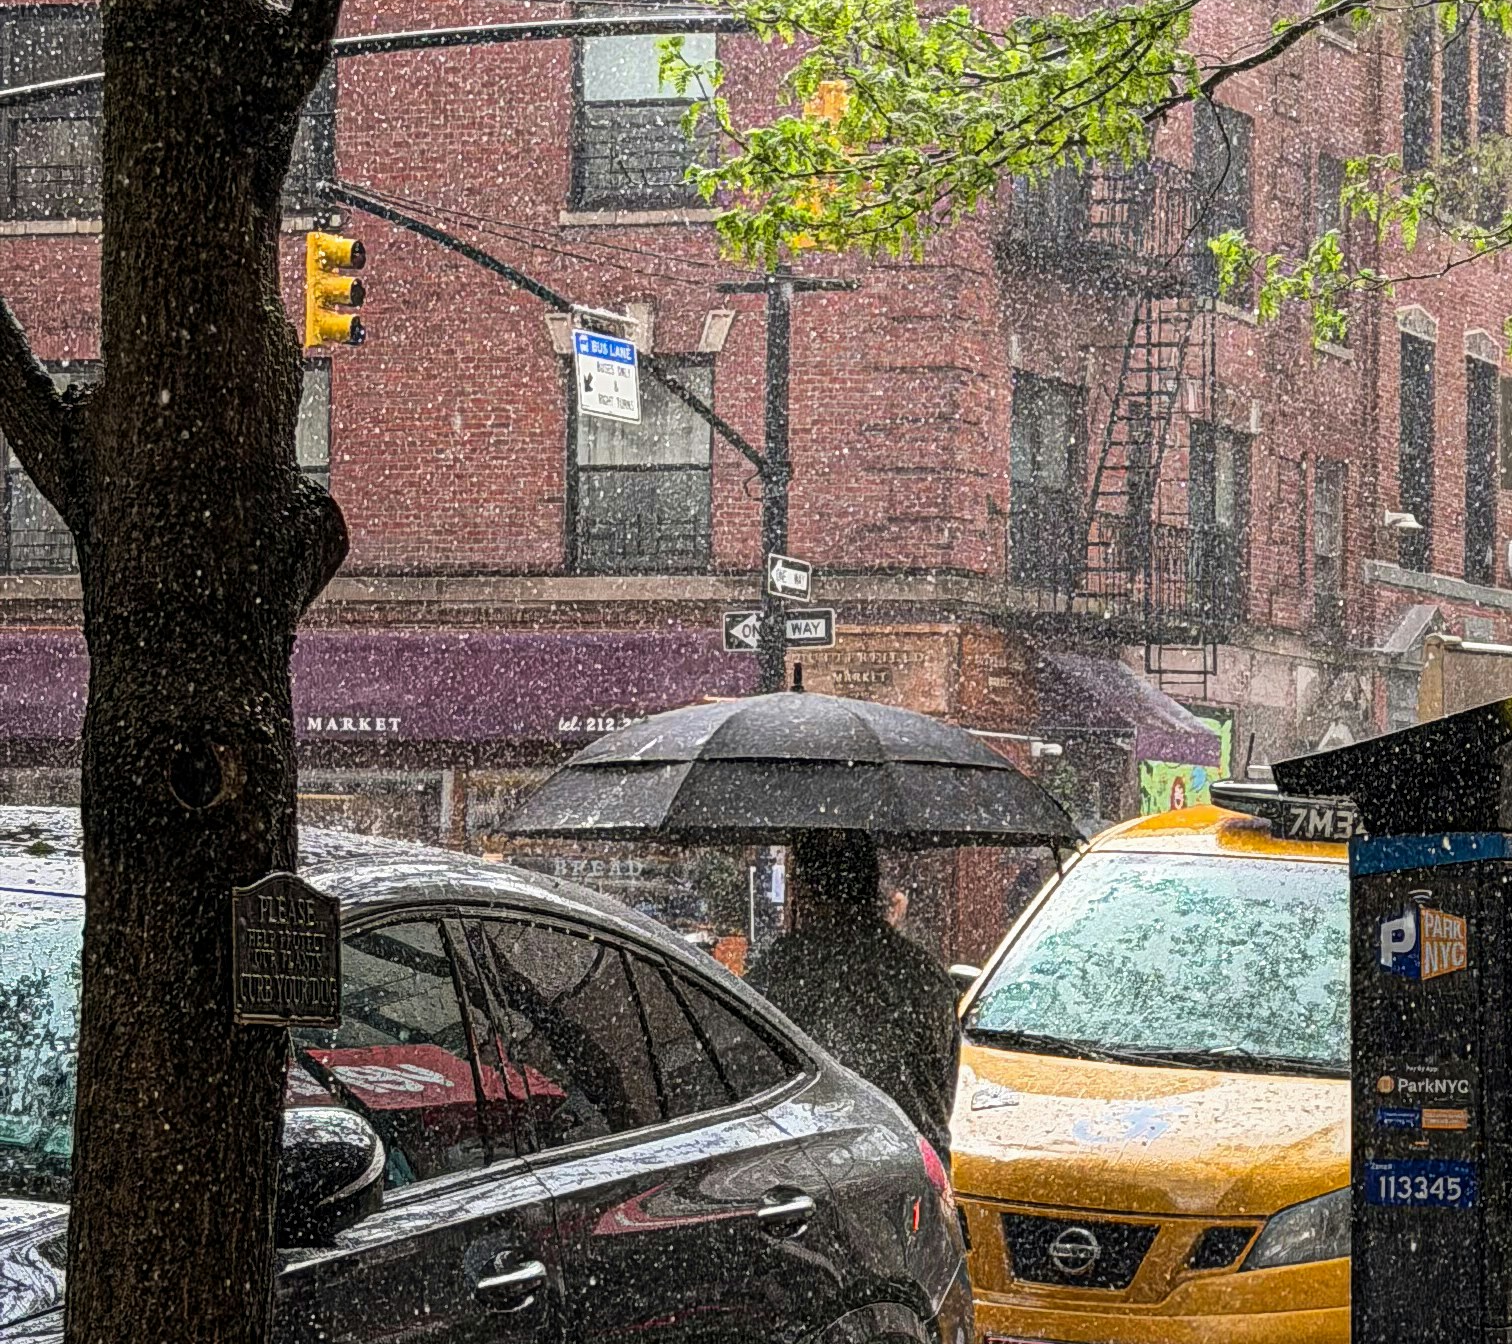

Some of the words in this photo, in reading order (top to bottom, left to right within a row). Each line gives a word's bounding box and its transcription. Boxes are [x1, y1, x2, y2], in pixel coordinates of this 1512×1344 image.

[591, 339, 609, 356] BUS
[609, 344, 633, 361] LANE
[741, 623, 762, 639] ON
[791, 621, 822, 637] WAY
[833, 670, 888, 683] MARKET
[306, 716, 401, 732] MARKET
[553, 859, 644, 876] BREAD
[258, 894, 315, 926] PLEASE
[1424, 911, 1464, 939] PARK
[1380, 912, 1417, 968] P
[1424, 940, 1465, 974] NYC
[1398, 1077, 1470, 1094] ParkNYC
[1379, 1175, 1462, 1201] 113345
